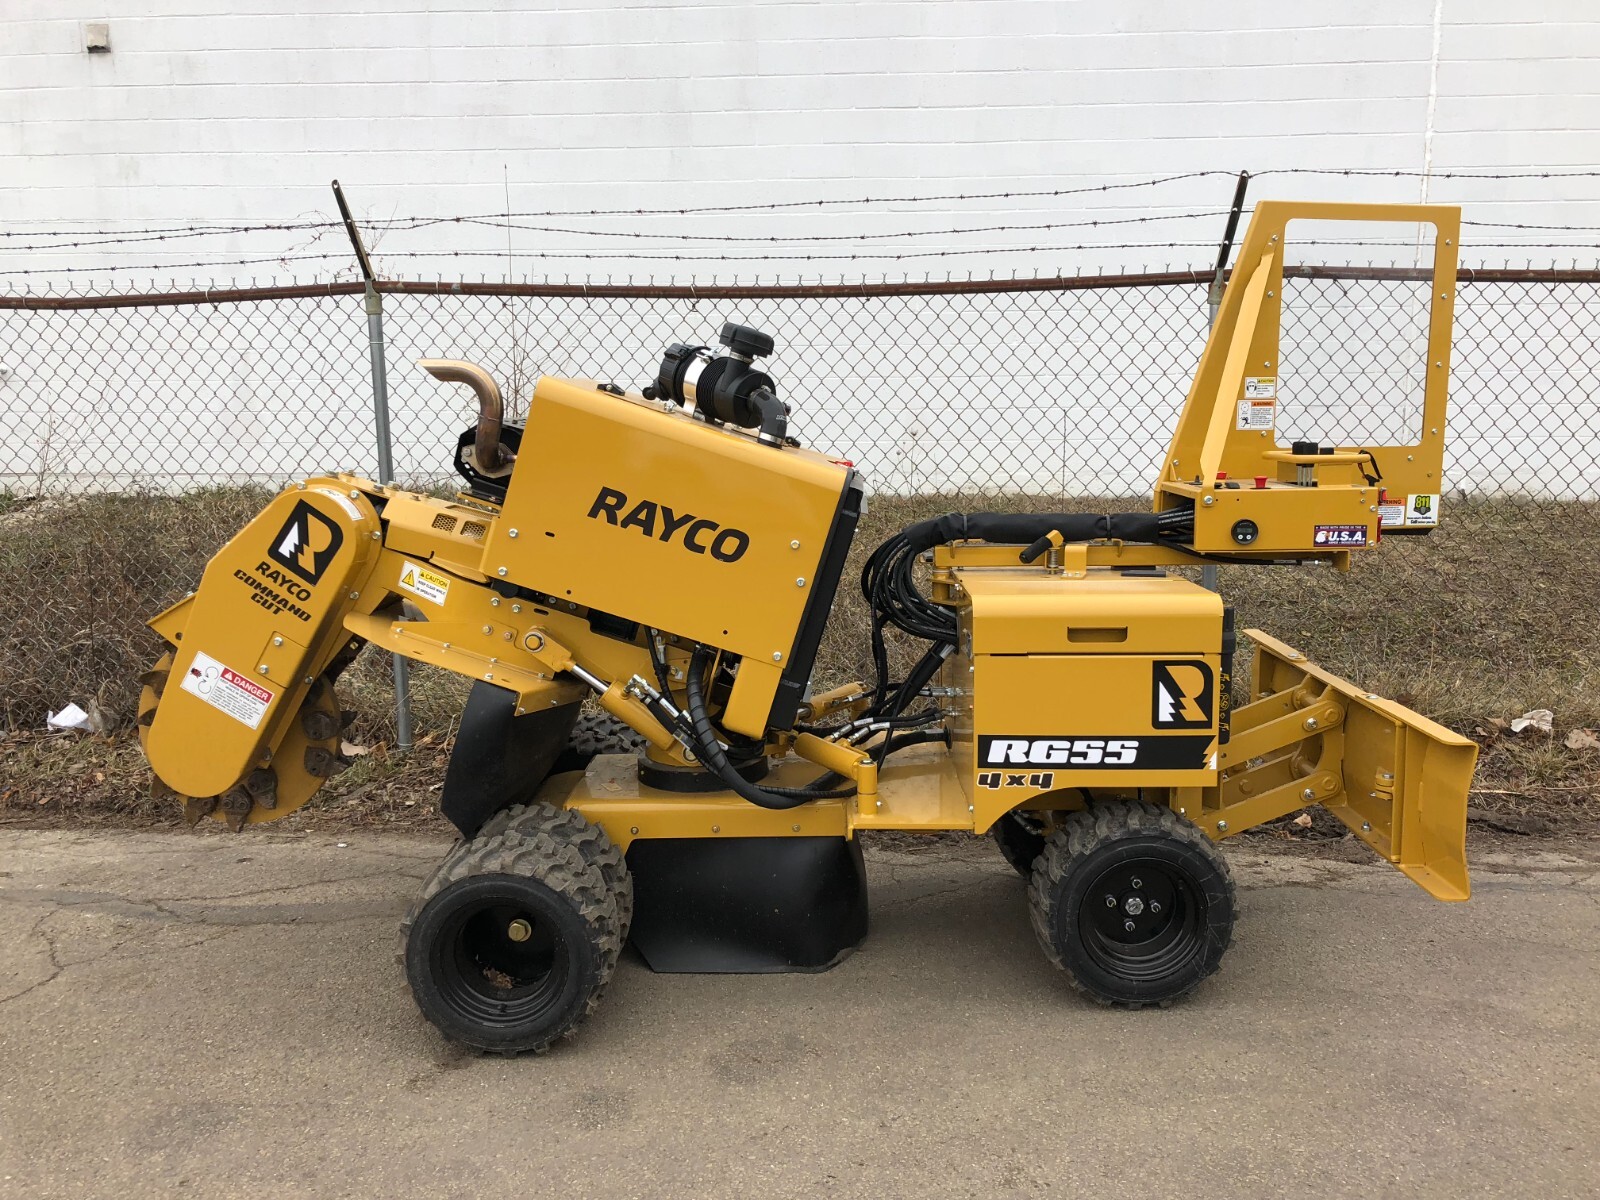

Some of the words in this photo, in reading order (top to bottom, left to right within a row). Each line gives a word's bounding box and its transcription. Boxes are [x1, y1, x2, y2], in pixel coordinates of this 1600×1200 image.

[1415, 496, 1431, 508] 811
[587, 486, 750, 563] RAYCO
[1328, 531, 1366, 541] U.S.A.
[255, 561, 312, 602] RAYCO
[425, 573, 448, 587] CAUTION
[233, 569, 312, 622] COMMAND
[250, 592, 285, 615] CUT
[233, 676, 269, 701] DANGER
[987, 739, 1139, 764] RG55
[977, 771, 1054, 790] 4x4
